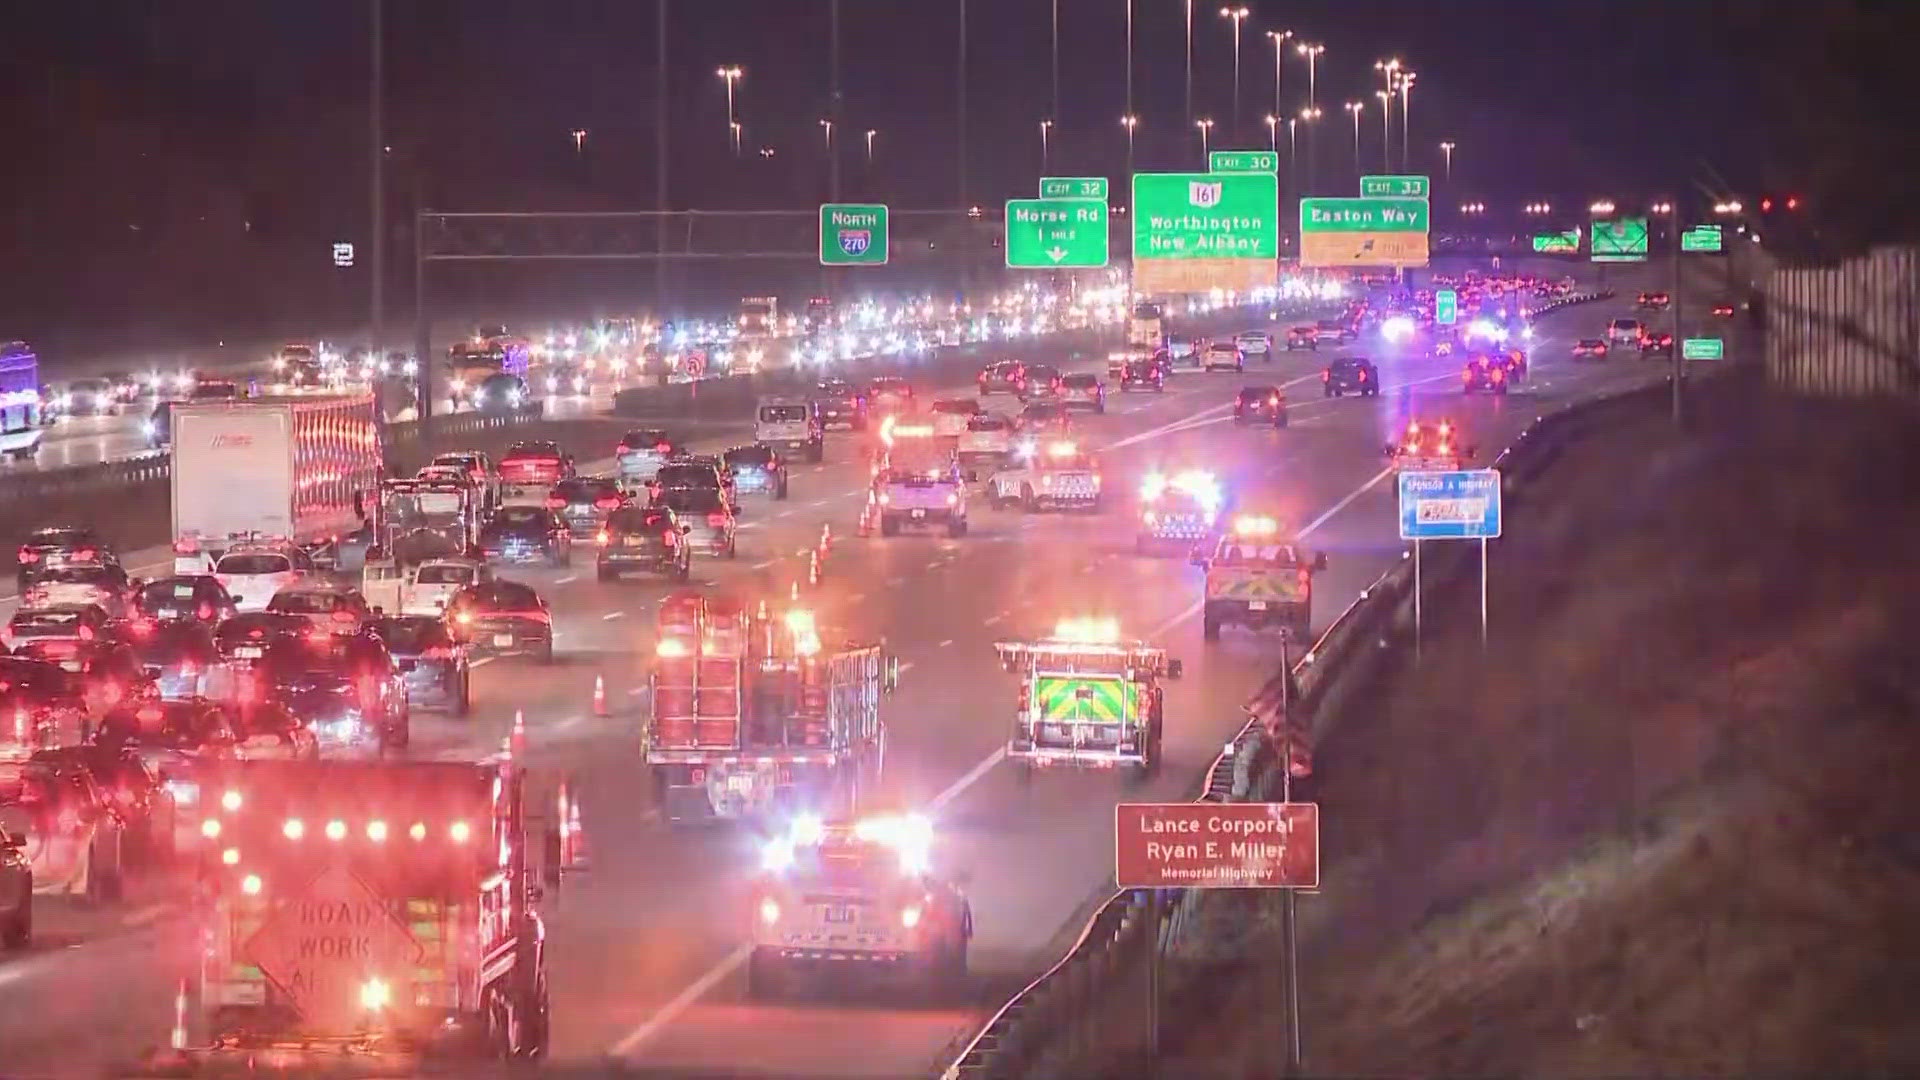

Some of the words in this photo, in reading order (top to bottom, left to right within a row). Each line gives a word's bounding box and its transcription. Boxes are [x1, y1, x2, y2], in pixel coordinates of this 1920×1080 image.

[1217, 158, 1239, 167] EXIT
[1250, 157, 1271, 168] 30
[1047, 183, 1070, 194] EXIT
[1081, 181, 1100, 195] 32
[1196, 187, 1215, 202] 161
[1368, 182, 1391, 193] EXIT
[1401, 181, 1421, 195] 33
[1016, 208, 1068, 222] Morse
[1077, 208, 1098, 222] Rd
[1311, 208, 1372, 222] Easton
[1382, 208, 1418, 225] Way
[1150, 215, 1262, 232] Worthington
[1051, 230, 1076, 241] MILE
[1150, 236, 1185, 250] New
[1197, 234, 1261, 251] Albany
[844, 238, 866, 251] 270
[1407, 480, 1443, 490] SPONSOR
[1448, 480, 1454, 490] A
[1459, 480, 1493, 490] HIGHWAY
[1141, 815, 1200, 833] Lance
[1208, 816, 1293, 836] Corporal
[1147, 842, 1197, 862] Ryan
[1205, 842, 1223, 859] E.
[1231, 841, 1287, 859] Miller
[1161, 866, 1217, 880] Memorial
[1220, 867, 1273, 881] Highway
[300, 902, 371, 925] ROAD
[299, 936, 370, 958] WORK
